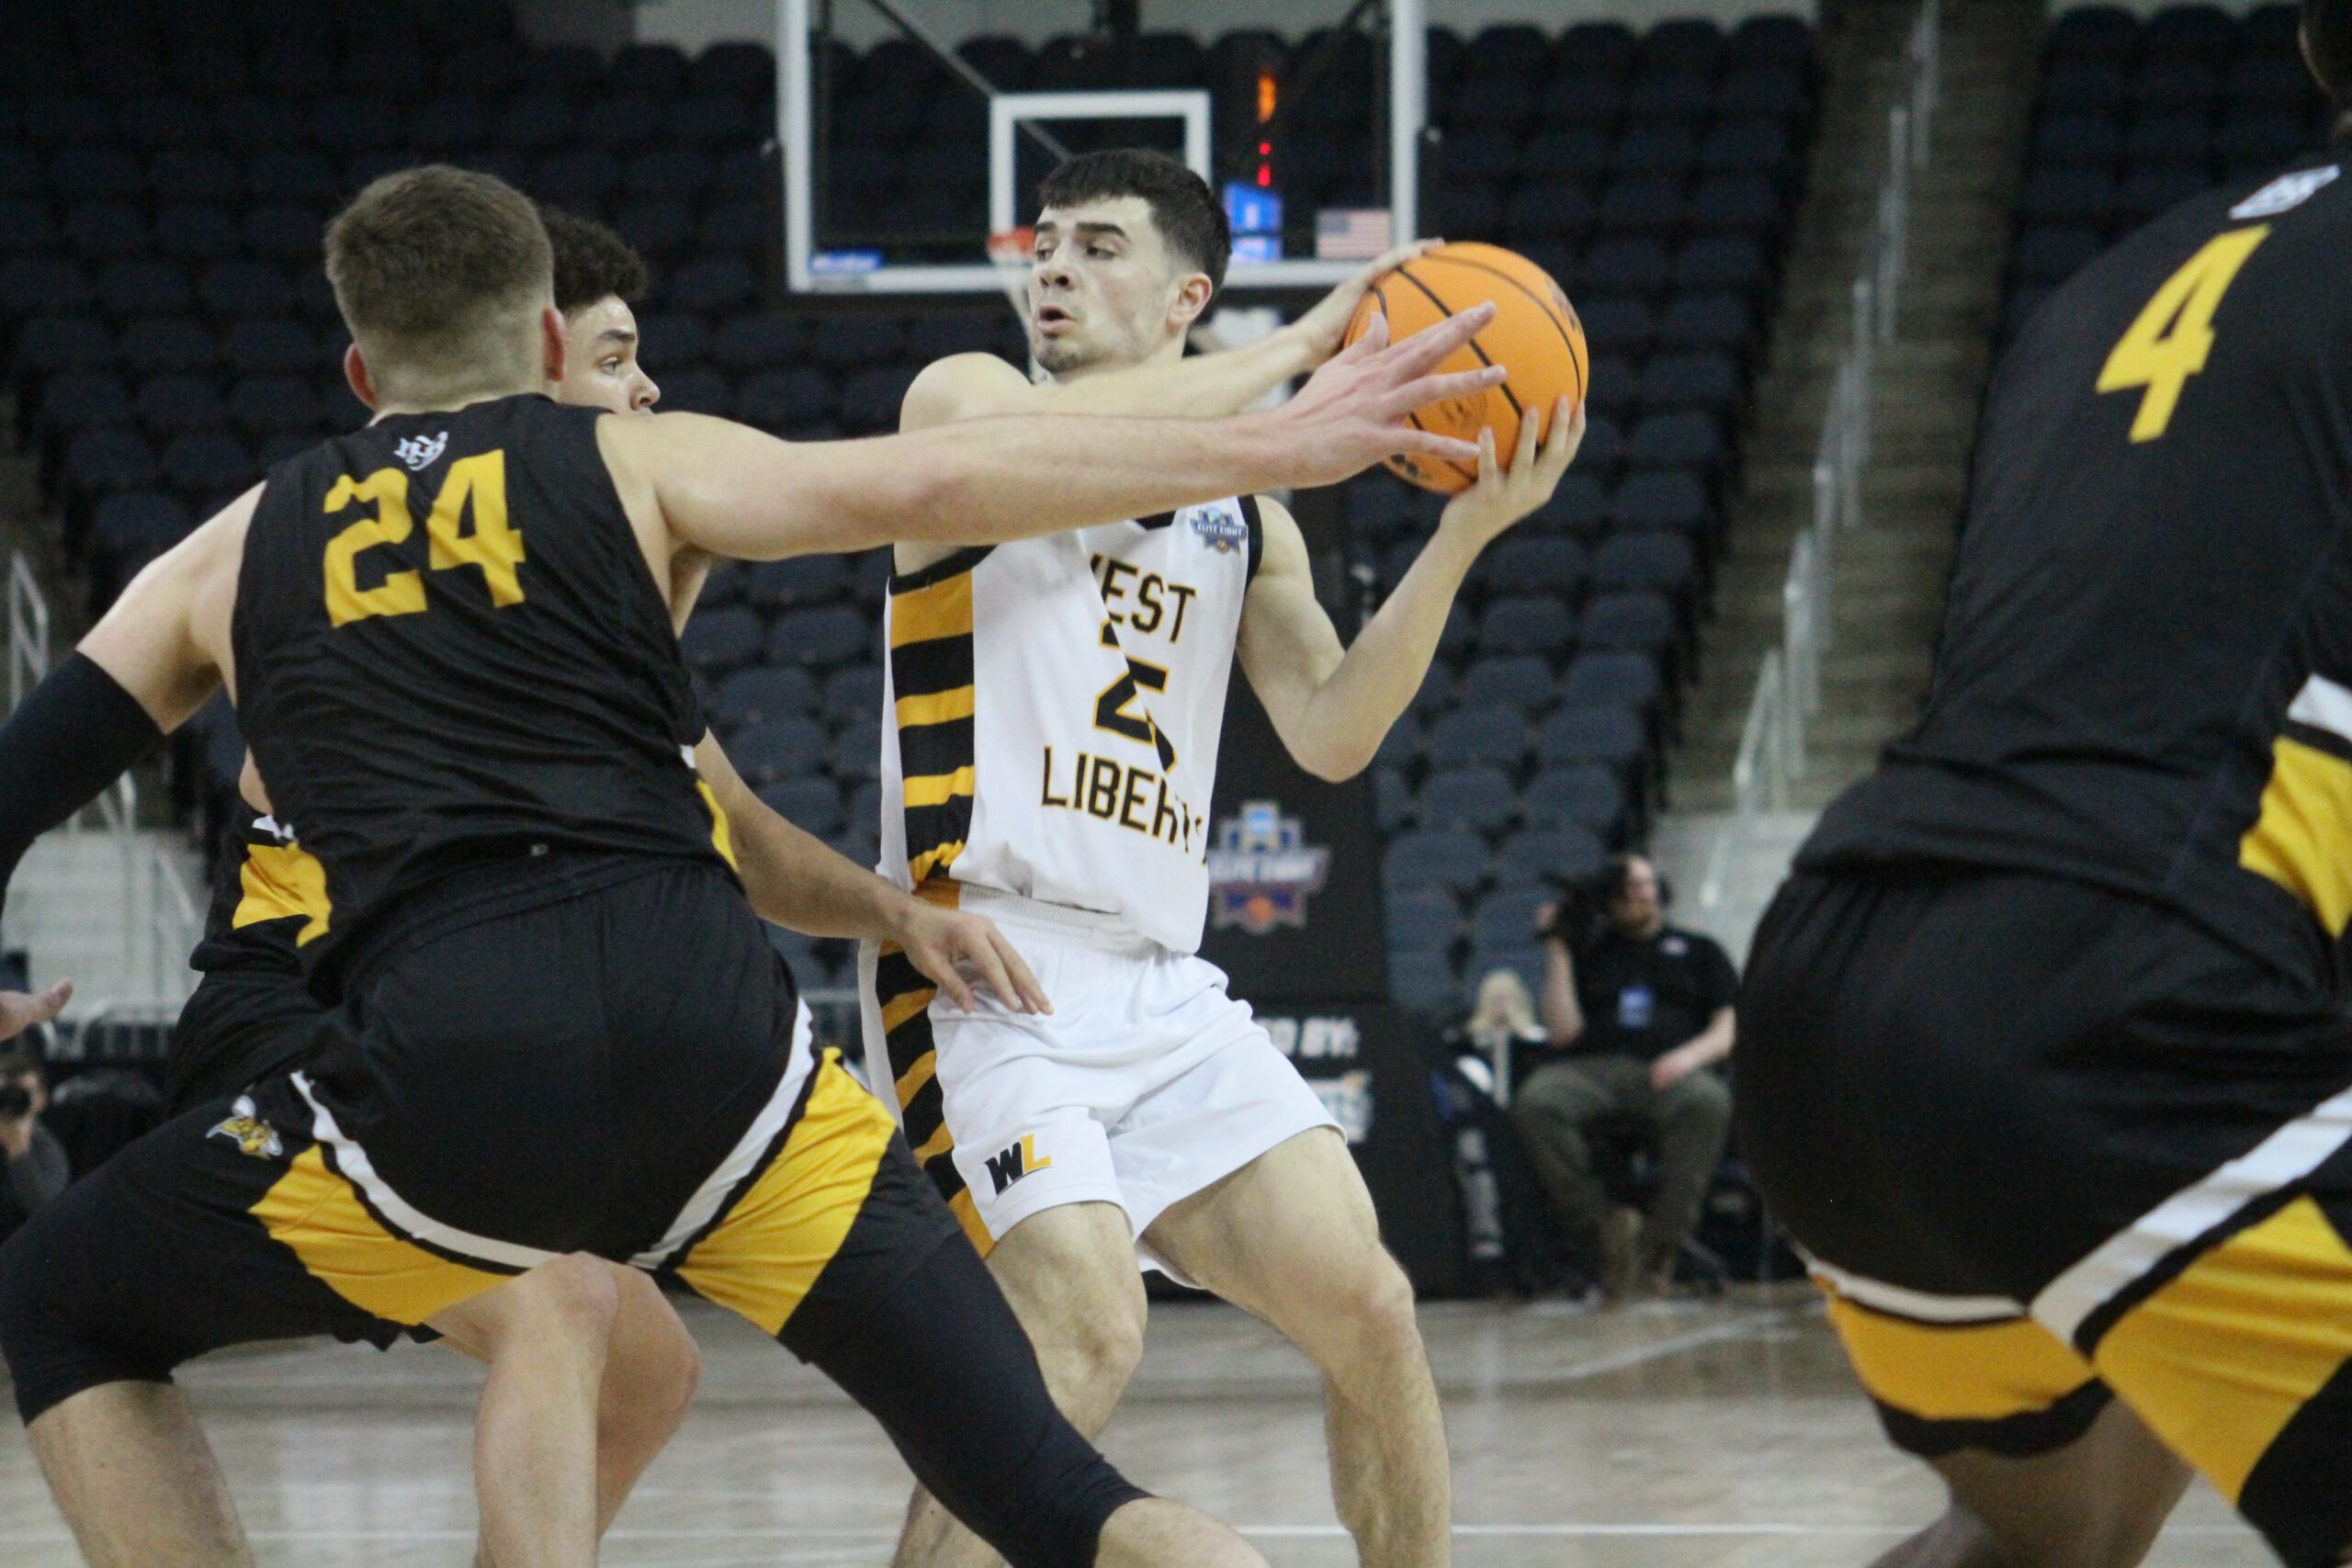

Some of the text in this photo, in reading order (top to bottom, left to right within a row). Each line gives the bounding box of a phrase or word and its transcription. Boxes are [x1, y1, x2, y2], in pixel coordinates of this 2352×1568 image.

[2096, 223, 2272, 445] 4
[323, 447, 525, 627] 24
[1091, 551, 1196, 645] EST
[1041, 745, 1207, 866] LIBER
[984, 1133, 1052, 1195] WL
